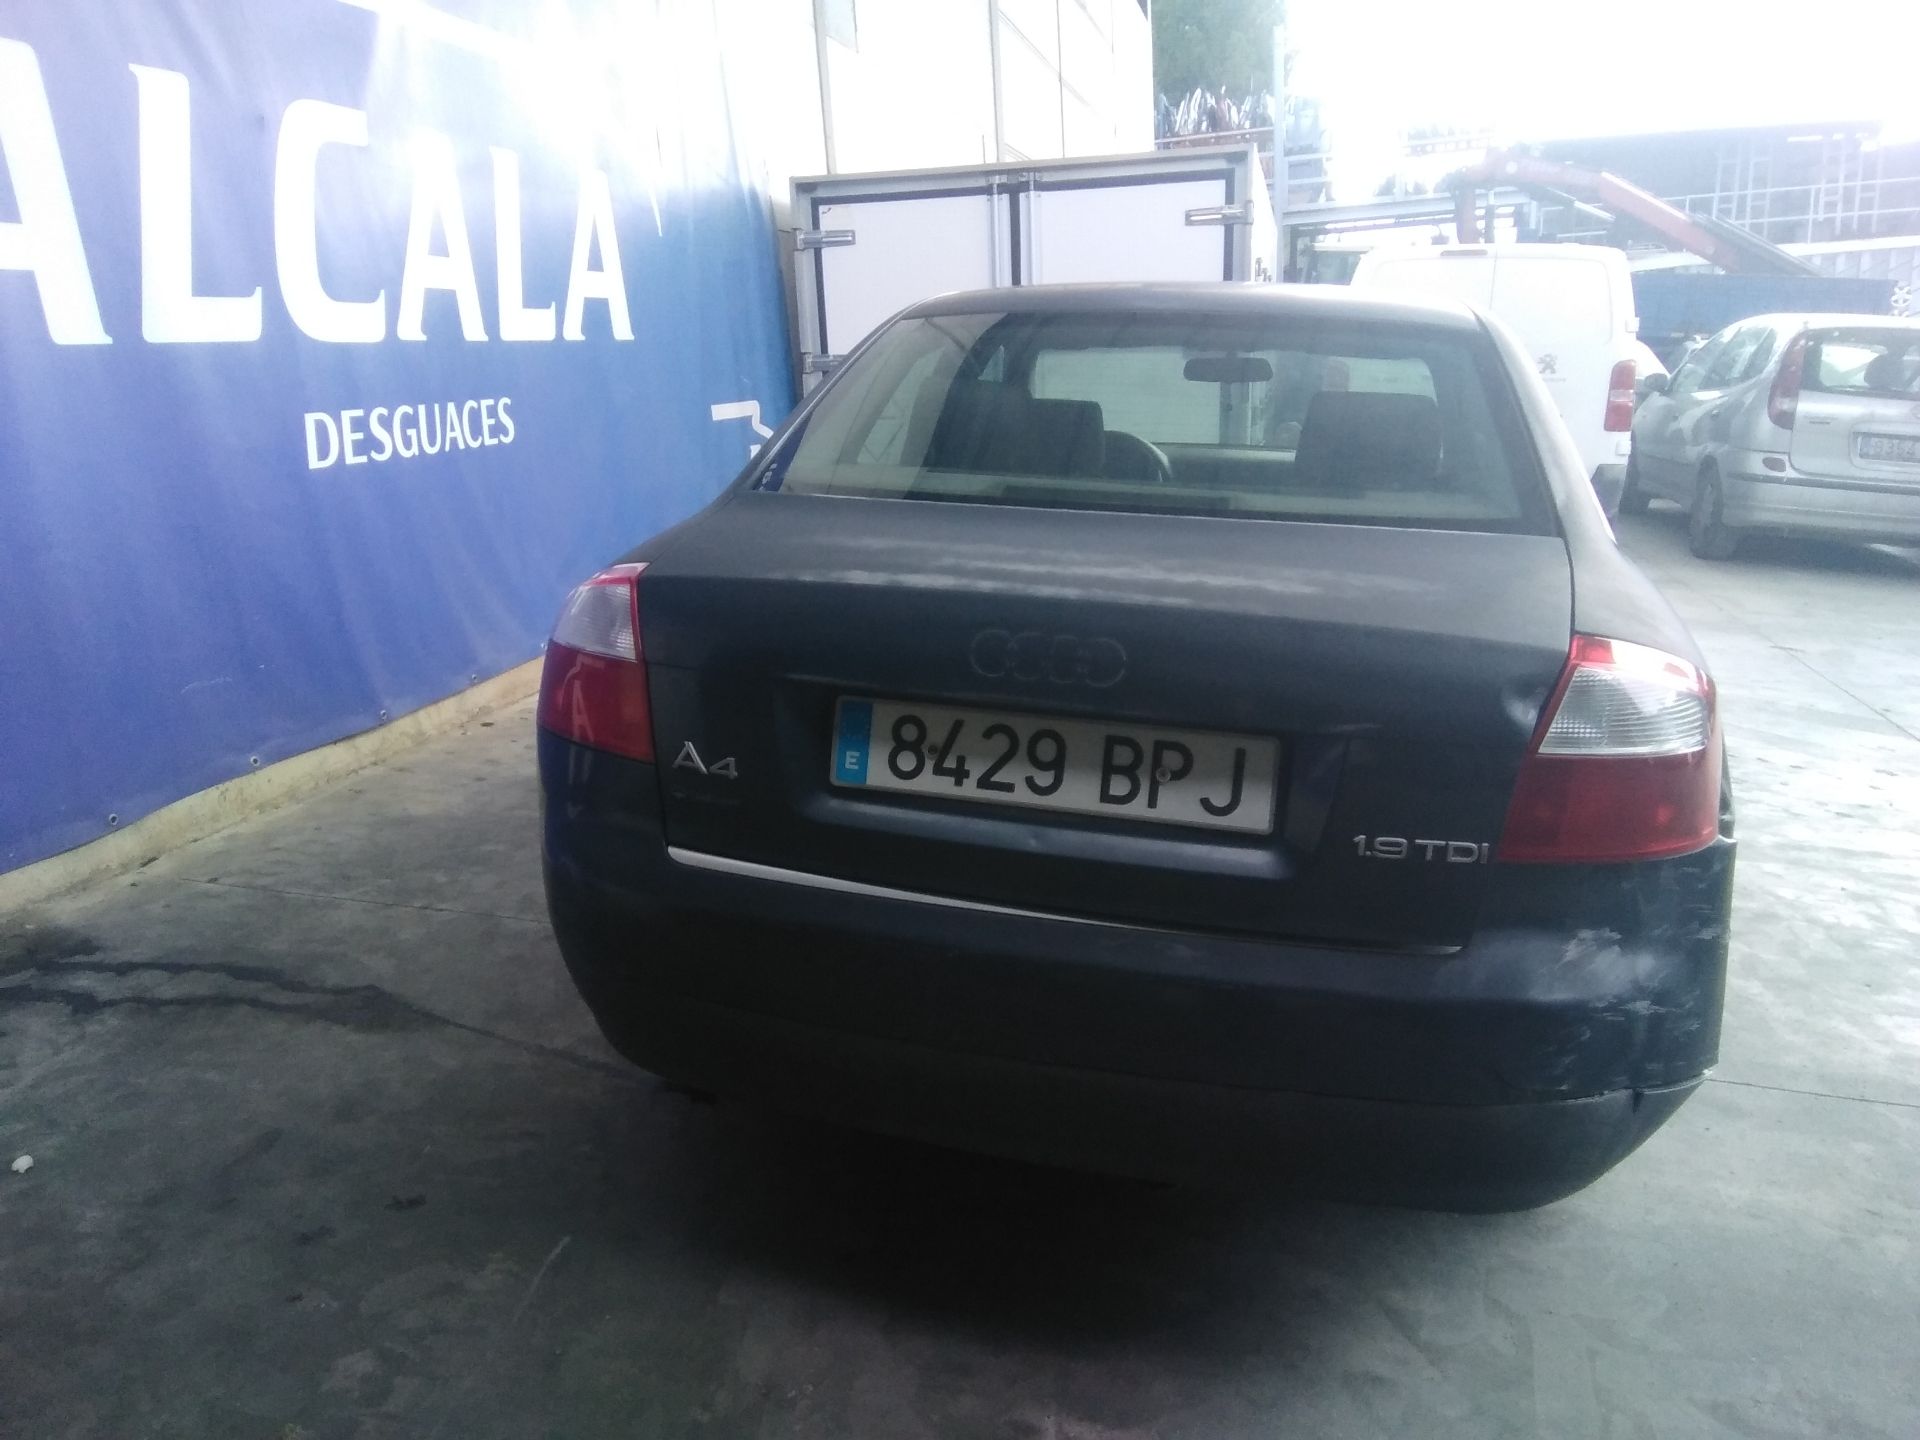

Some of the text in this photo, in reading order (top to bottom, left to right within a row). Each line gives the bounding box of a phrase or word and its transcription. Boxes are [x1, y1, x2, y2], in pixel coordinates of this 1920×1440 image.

[304, 397, 516, 469] DESGUACES
[671, 740, 738, 780] A4
[843, 751, 860, 770] E
[887, 714, 1247, 817] 8429 BPJ
[1414, 839, 1490, 864] TDI
